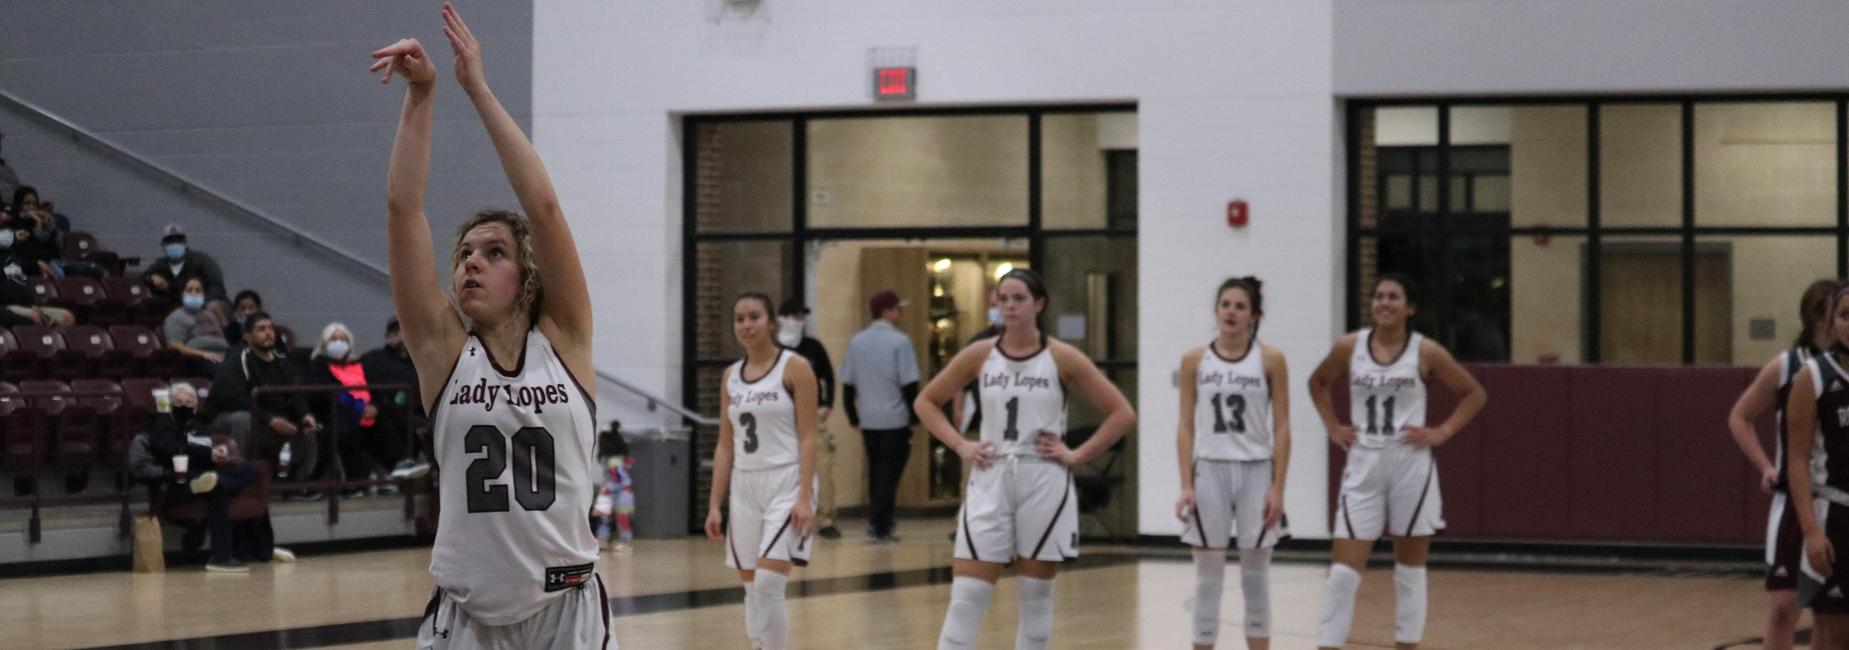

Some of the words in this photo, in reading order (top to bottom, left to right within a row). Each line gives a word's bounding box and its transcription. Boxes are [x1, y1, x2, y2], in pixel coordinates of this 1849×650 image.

[503, 383, 568, 414] Lopes
[983, 371, 1009, 389] Lady
[1014, 371, 1049, 391] Lopes
[739, 412, 758, 454] 3
[1003, 396, 1018, 441] 1
[1211, 392, 1246, 433] 13
[1365, 395, 1395, 436] 11
[464, 424, 556, 513] 20
